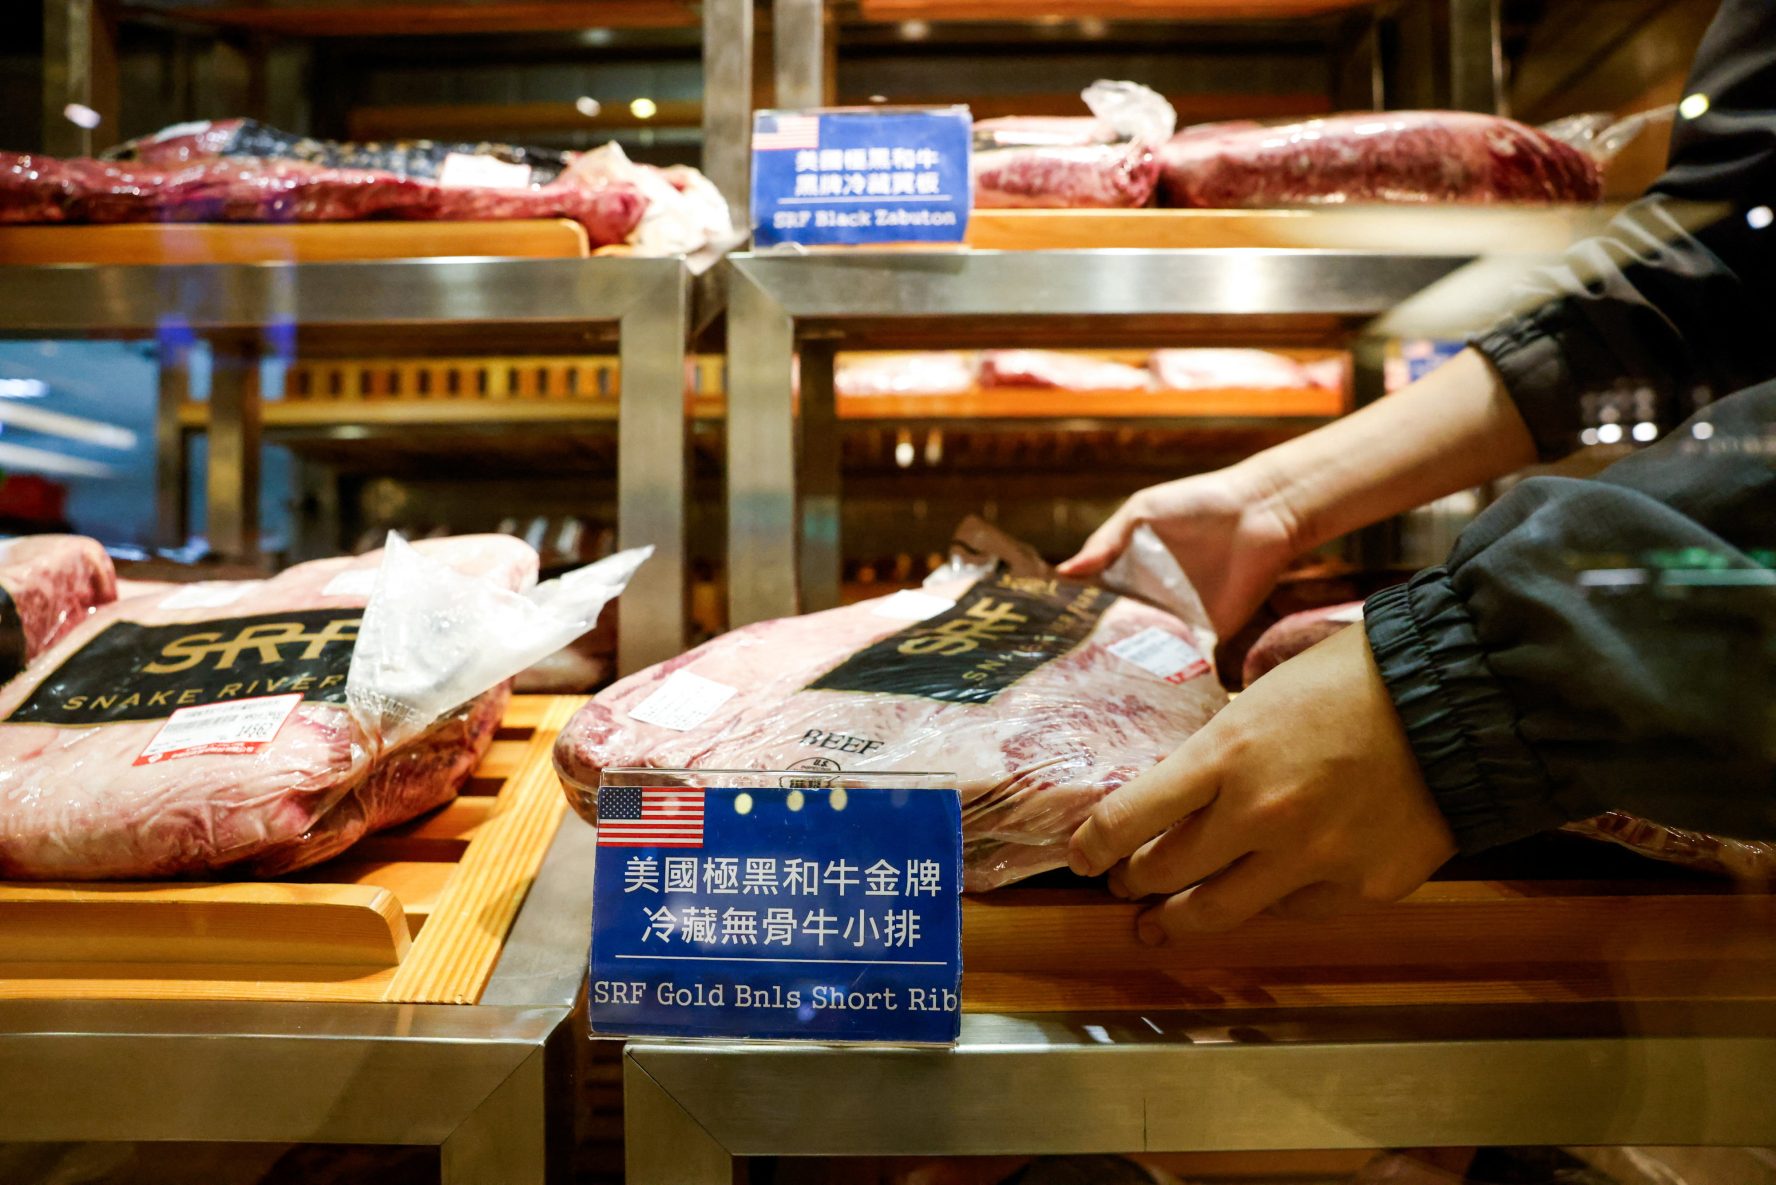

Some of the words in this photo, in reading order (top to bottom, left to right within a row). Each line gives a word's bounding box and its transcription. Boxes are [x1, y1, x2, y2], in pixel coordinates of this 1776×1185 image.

[815, 209, 871, 227] Black
[874, 208, 957, 226] Zabuton
[62, 689, 203, 710] SNAKE
[218, 674, 345, 695] RIVER
[799, 729, 885, 755] BEEF
[623, 856, 942, 897] 美國極黑和牛金牌
[641, 906, 921, 948] 冷藏無骨牛小排
[594, 981, 647, 1005] SRF
[656, 983, 725, 1007] Gold
[735, 985, 801, 1009] Bnls
[812, 987, 898, 1011] Short
[908, 988, 958, 1012] Rib
